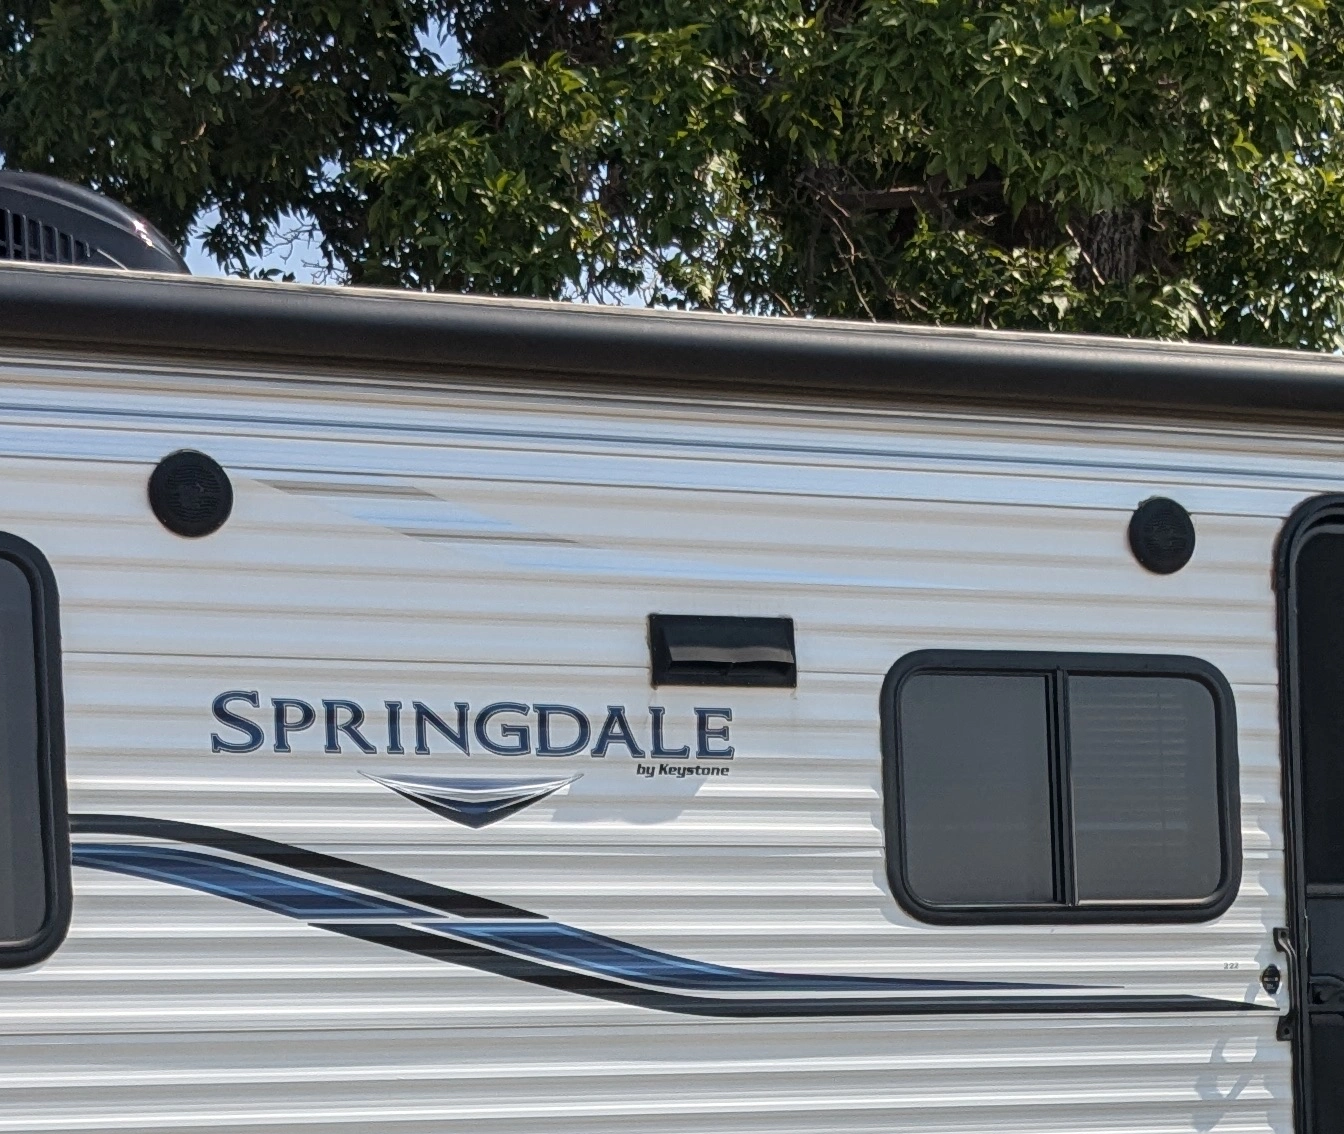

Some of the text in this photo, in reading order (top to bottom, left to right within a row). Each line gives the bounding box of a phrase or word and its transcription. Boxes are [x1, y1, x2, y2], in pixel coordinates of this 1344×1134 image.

[210, 690, 735, 760] SPRINGDALE
[636, 763, 730, 778] by Keystone
